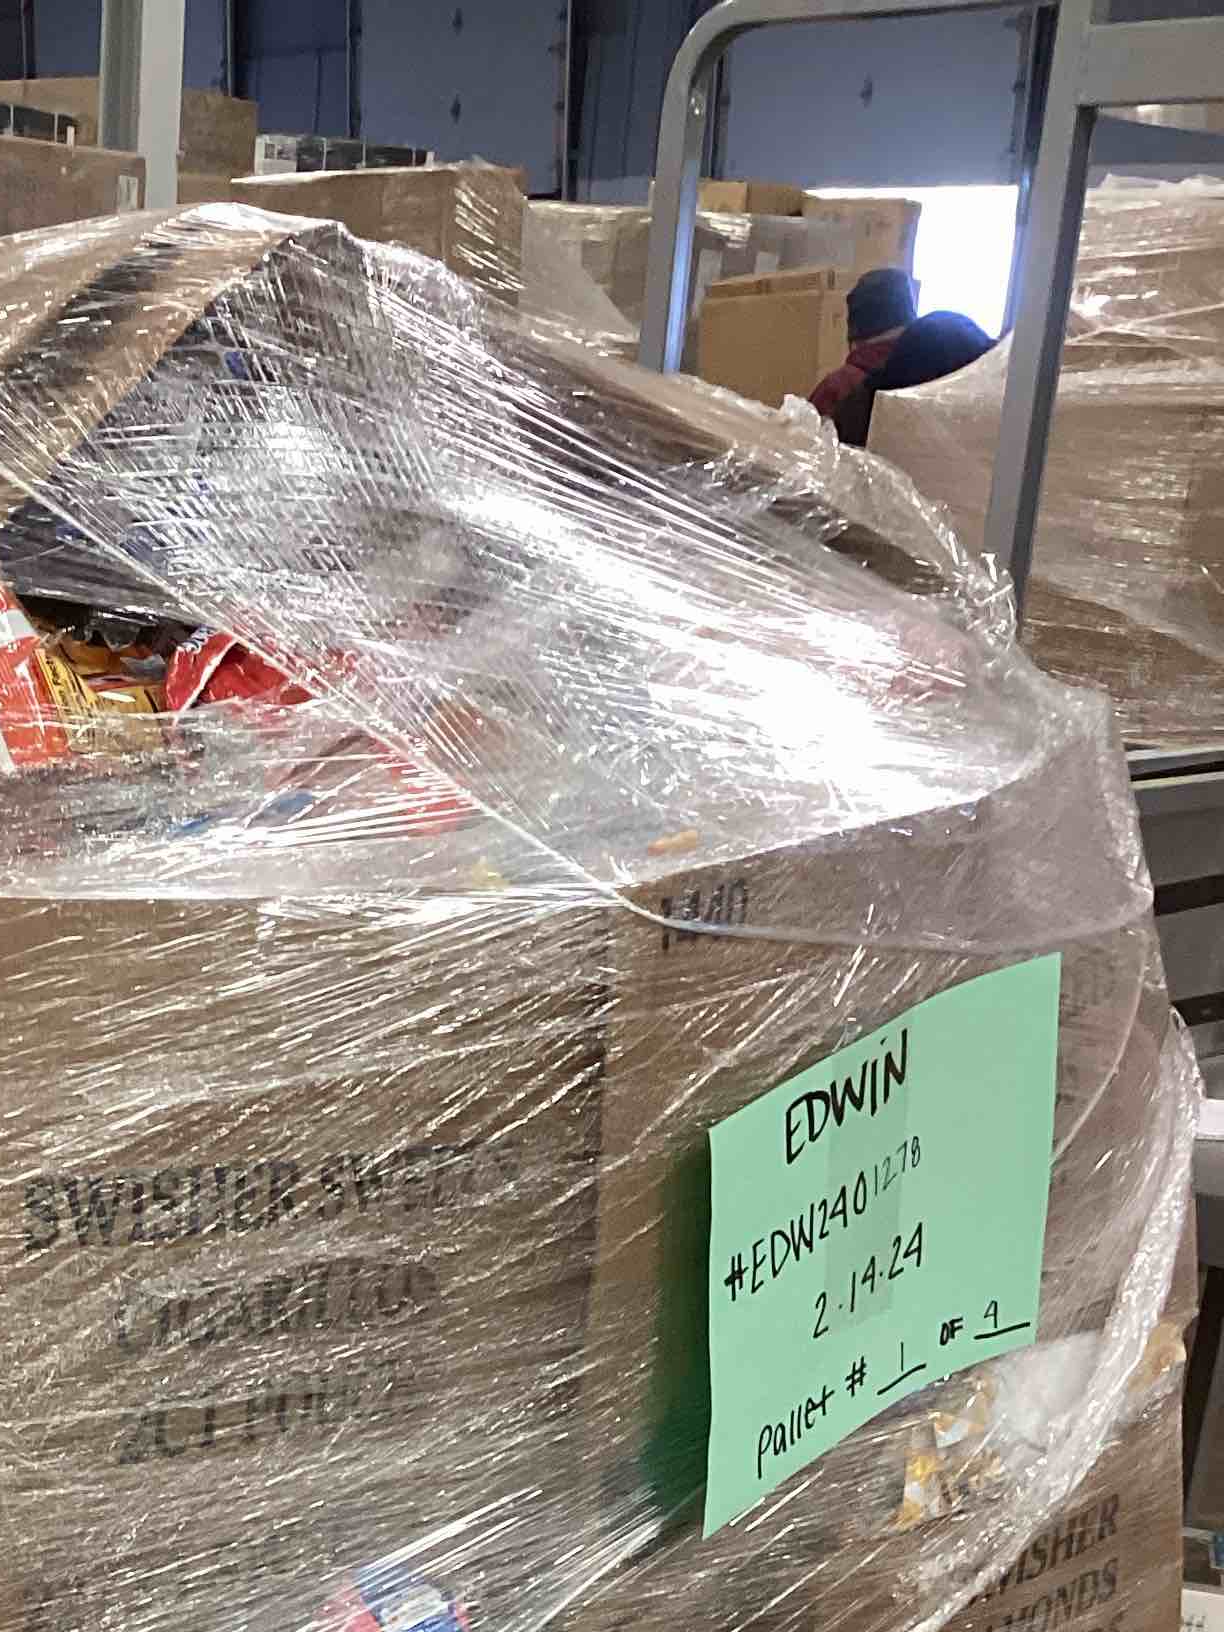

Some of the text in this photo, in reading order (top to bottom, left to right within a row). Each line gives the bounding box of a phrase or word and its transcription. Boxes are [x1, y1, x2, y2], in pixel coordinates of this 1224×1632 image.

[785, 1028, 908, 1165] EDWIN
[724, 1136, 922, 1302] #EDW2401278
[845, 1356, 868, 1397] #
